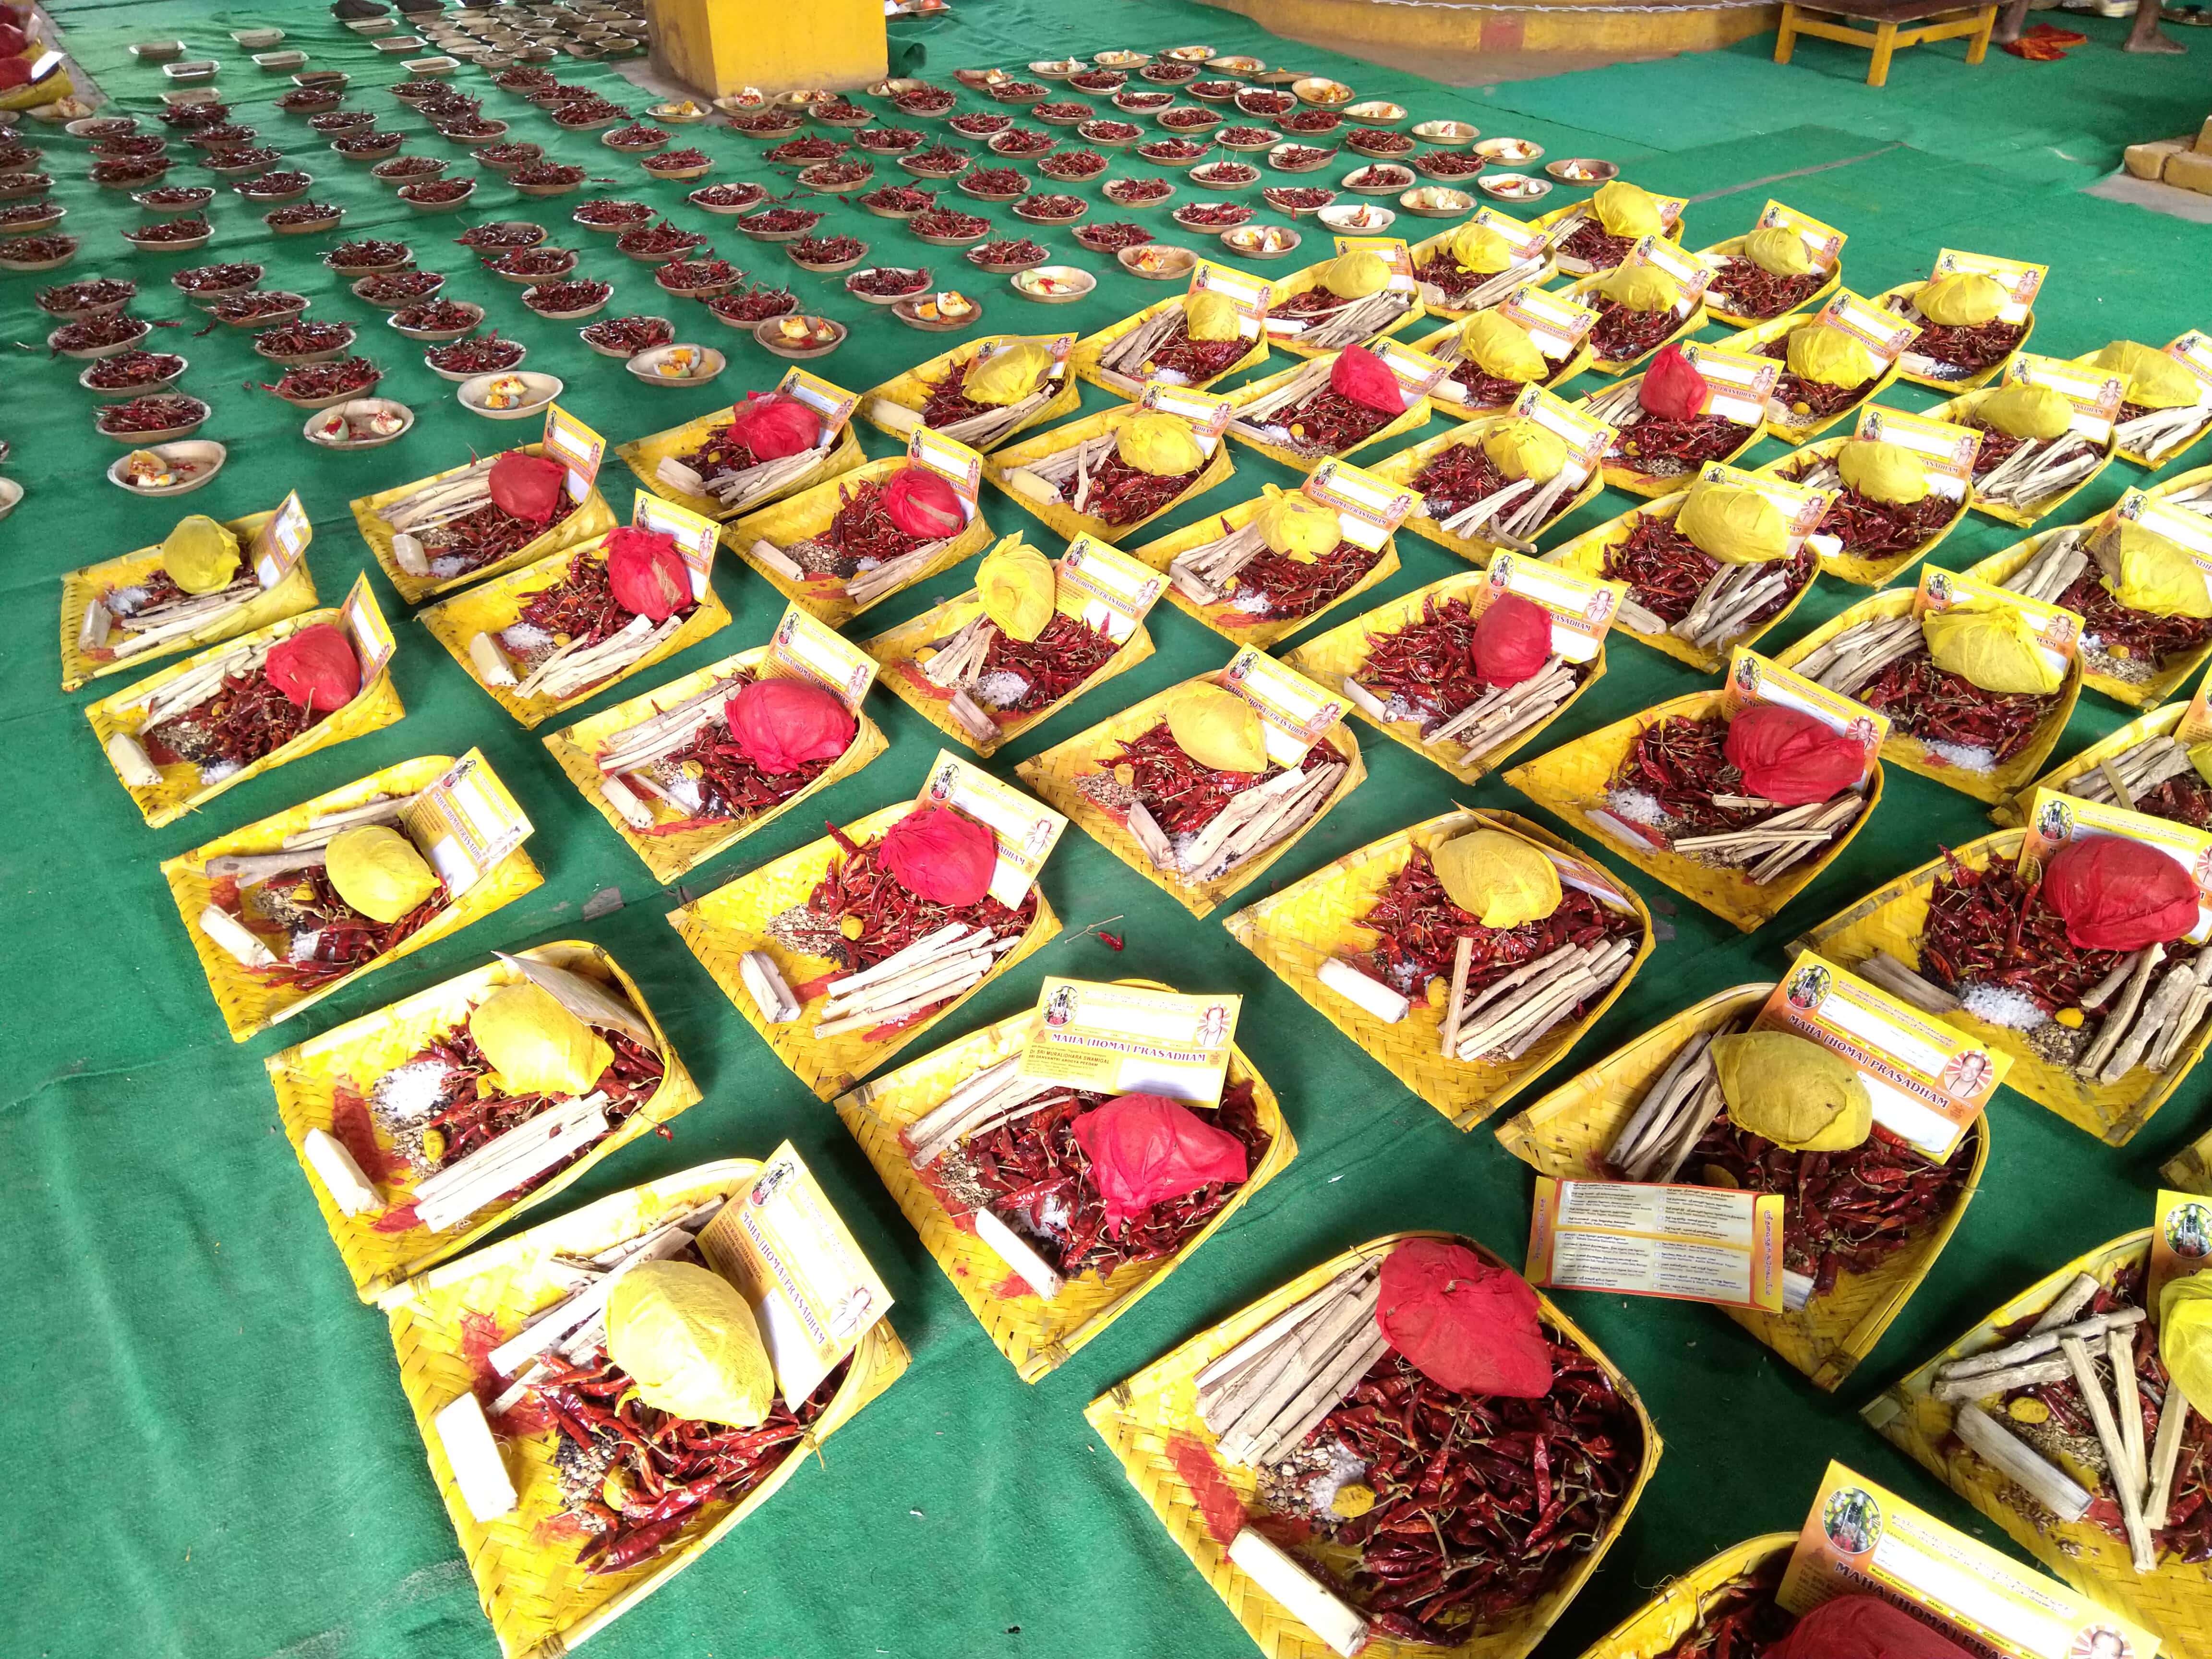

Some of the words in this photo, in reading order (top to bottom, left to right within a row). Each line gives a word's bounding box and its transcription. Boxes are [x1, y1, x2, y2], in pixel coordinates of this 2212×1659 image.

[1236, 306, 1257, 316] ASADHAM
[1719, 385, 1756, 399] PRASADHAM
[2074, 403, 2103, 414] ASADHAM
[1193, 425, 1213, 434] ADHAM
[1567, 449, 1586, 464] ADHAM
[1921, 458, 1958, 473] ASADHAM
[1349, 505, 1386, 525] PRASADHAM
[1065, 572, 1080, 583] MAHA
[1099, 590, 1135, 614] PRASADHAM
[1550, 612, 1591, 632] RASADHAM
[778, 651, 793, 666] MAHA
[814, 676, 849, 705] PRASADHAM
[1227, 683, 1244, 698] MAHA
[1269, 712, 1309, 738] PRASADHAM
[994, 841, 1025, 865] SADHAM
[1046, 1051, 1082, 1060] MURALIDHARA
[1083, 1056, 1110, 1064] SWAMIGAL
[1052, 1034, 1083, 1044] MAHA
[1087, 1038, 1130, 1052] (HOMA)
[1133, 1046, 1205, 1061] PRASADHAM
[1789, 1015, 1822, 1039] MAHA
[1824, 1034, 1869, 1064] (HOMA)
[1870, 1059, 1949, 1108] PRASADHAM
[741, 1212, 760, 1242] MAHA
[784, 1278, 825, 1344] PRASADHAM
[1835, 1561, 1886, 1598] MAHA
[1871, 1567, 1884, 1577] Mode
[1891, 1579, 1914, 1594] Despatch
[1927, 1599, 1944, 1611] HAND
[1955, 1615, 1972, 1626] POST
[1984, 1631, 2011, 1648] COURIER
